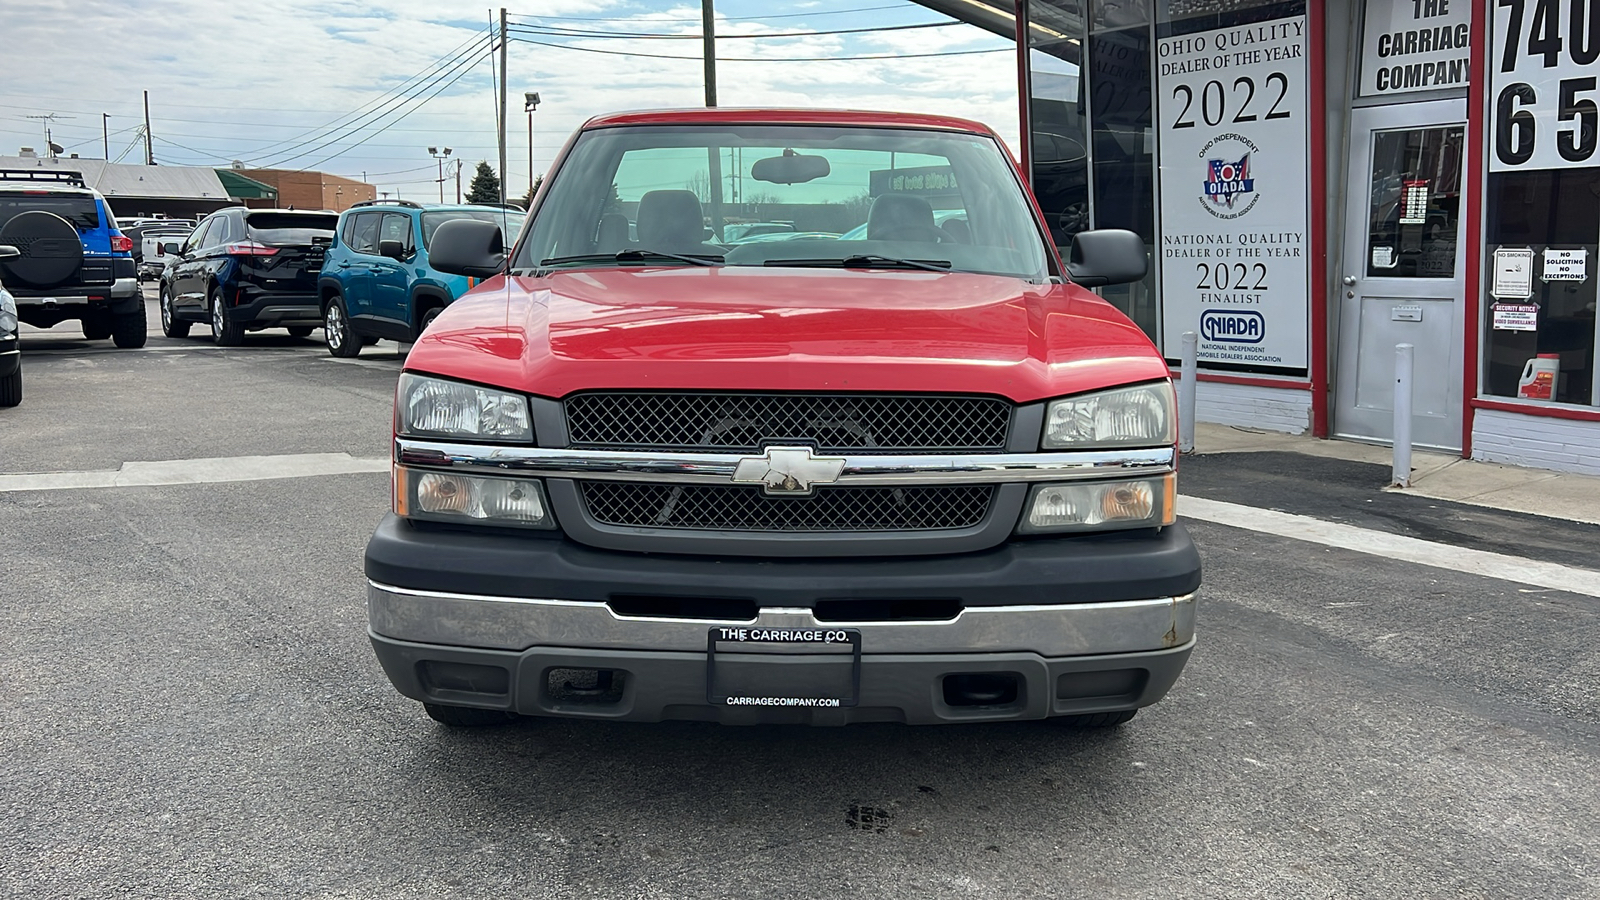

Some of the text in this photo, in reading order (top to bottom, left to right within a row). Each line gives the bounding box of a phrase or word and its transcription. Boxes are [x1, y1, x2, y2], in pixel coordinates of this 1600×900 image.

[1412, 0, 1449, 19] THE
[1159, 20, 1304, 57] OHIO QUALITY
[1378, 23, 1470, 57] CARRIAG
[1162, 44, 1301, 76] DEALER OF THE YEAR
[1172, 72, 1291, 129] 2022
[1198, 133, 1259, 158] OHIO INDEPENDENT
[1210, 180, 1245, 193] OIADA
[1198, 196, 1219, 218] AUTOMOBILE
[1238, 193, 1260, 217] ASSOCIATION
[1164, 233, 1302, 245] NATIONAL QUALITY
[1166, 248, 1300, 258] DEALER OF THE YEAR
[1196, 262, 1268, 290] 2022
[1201, 293, 1261, 304] FINALIST
[1206, 317, 1258, 336] NIADA
[720, 628, 849, 641] THE CARRIAGE CO.
[727, 697, 839, 707] CARRIAGECOMPANY.COM
